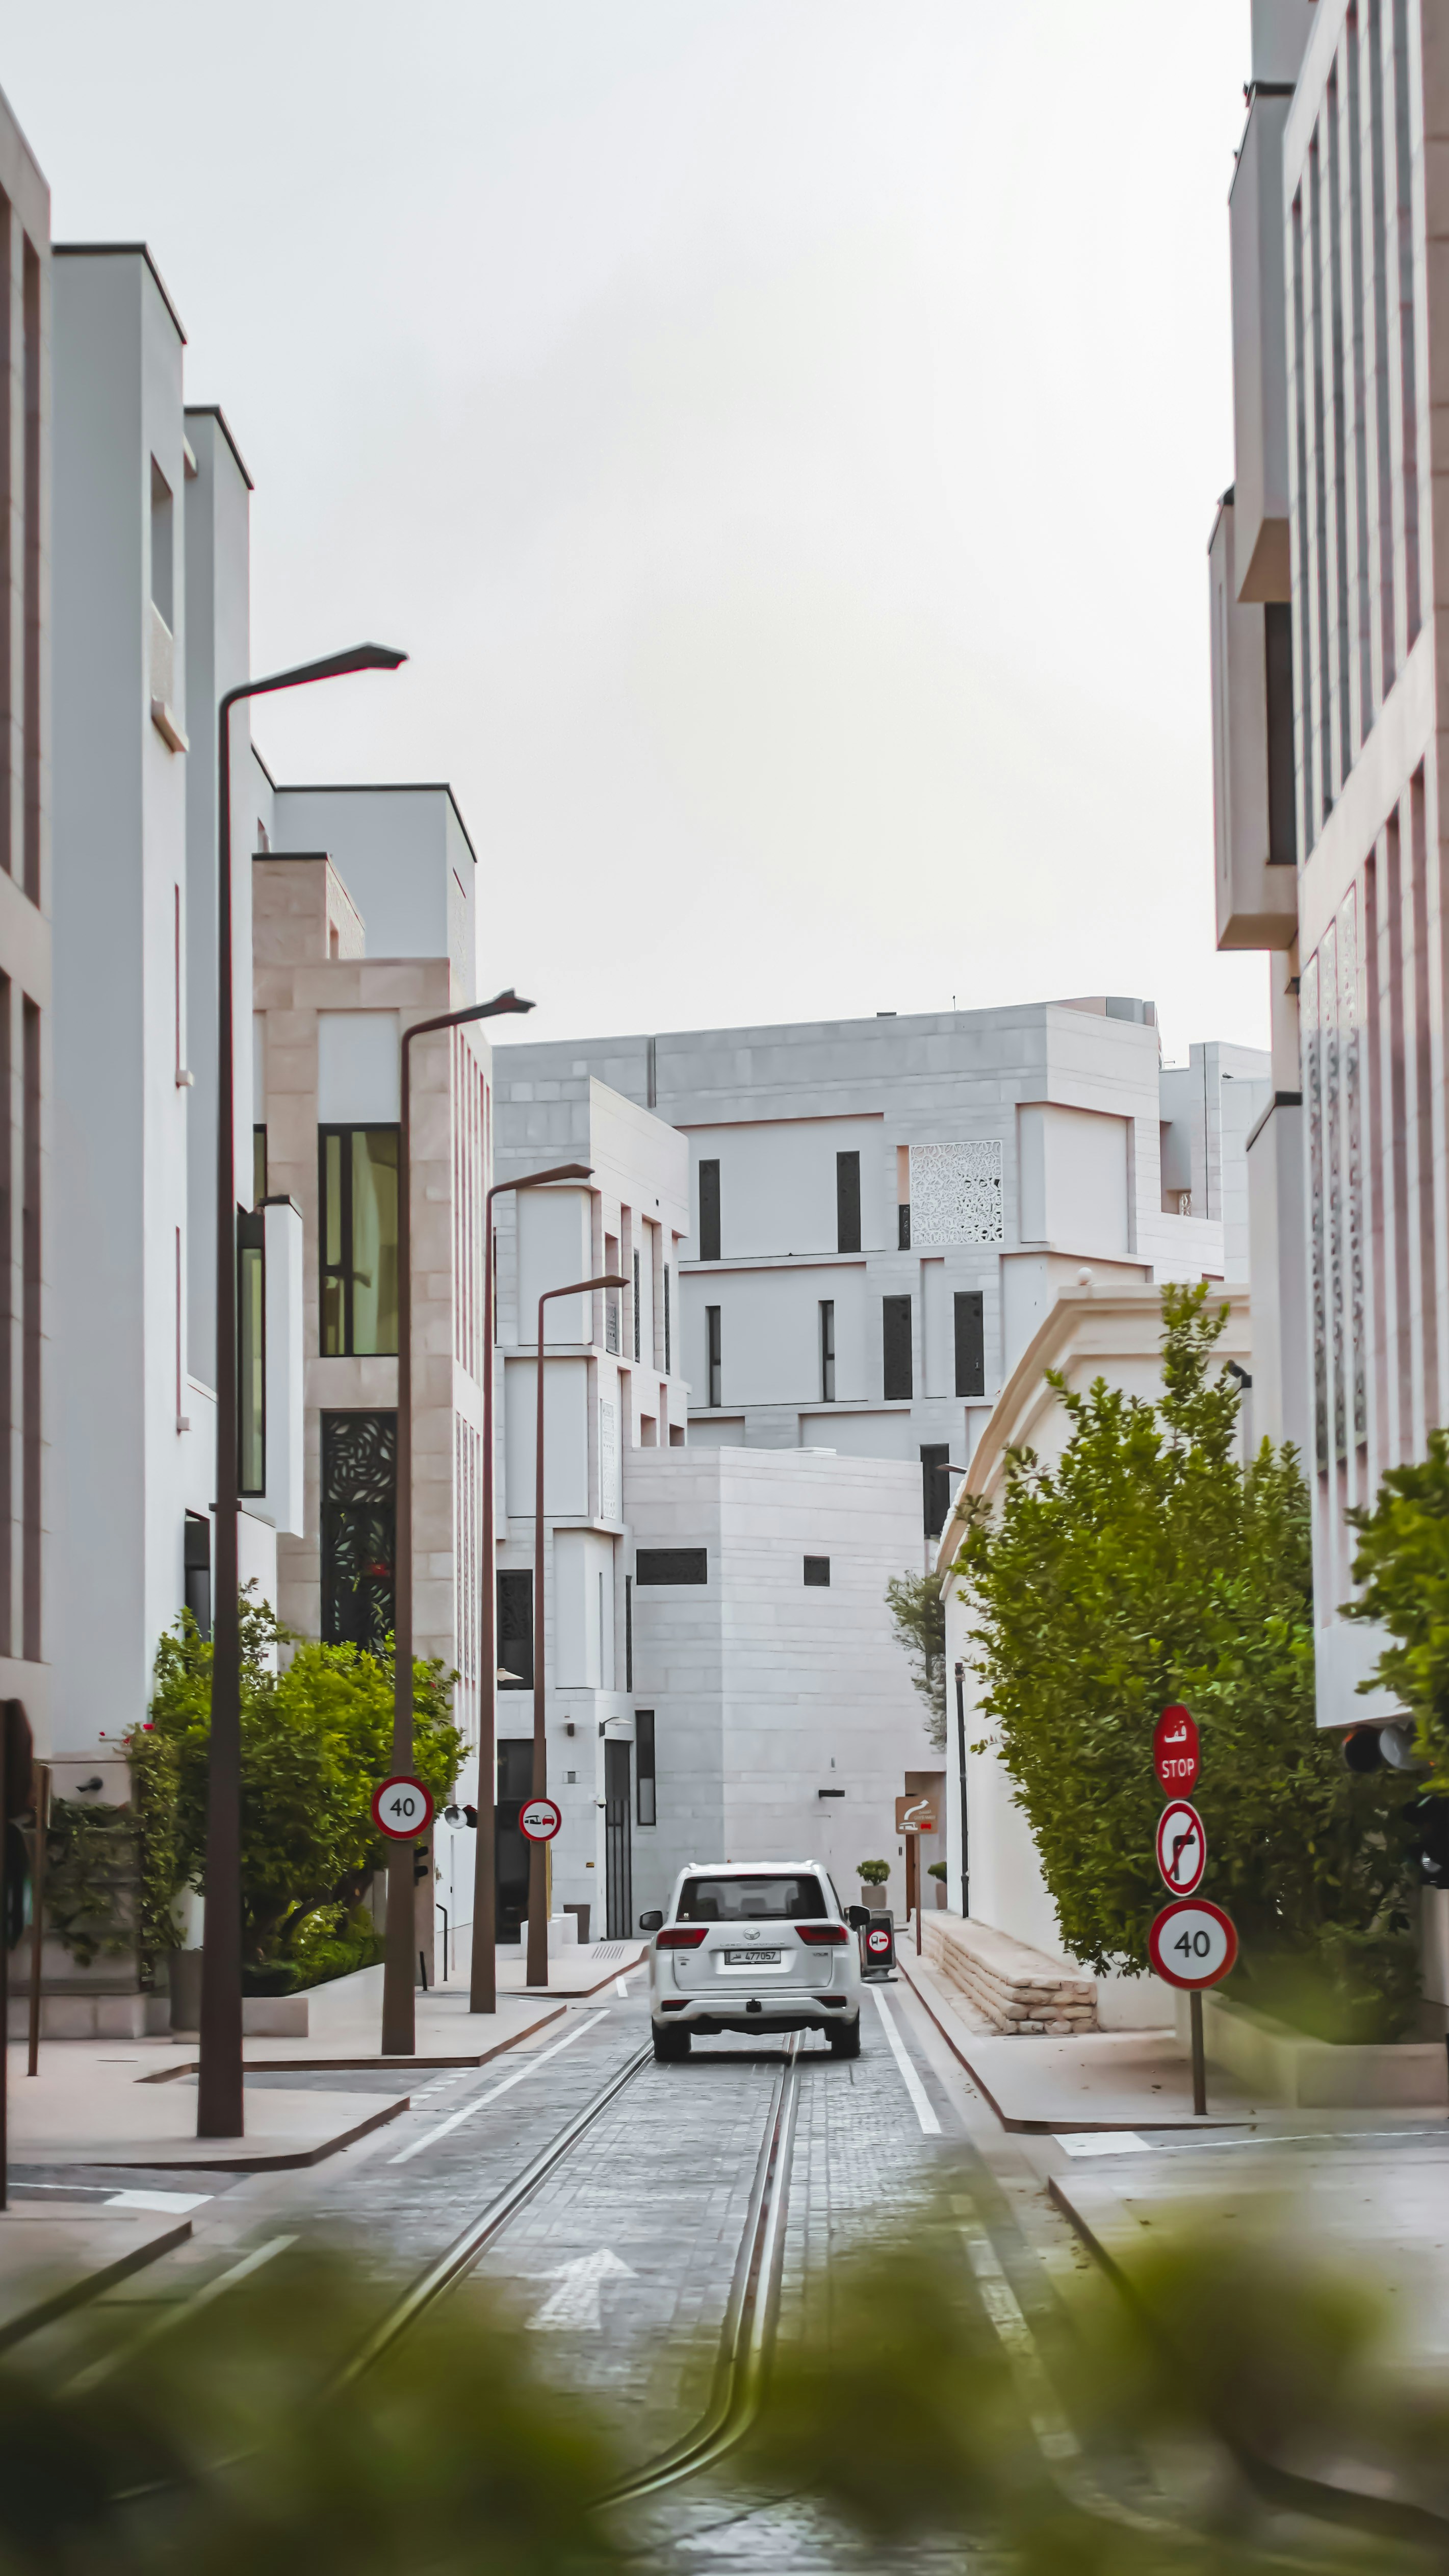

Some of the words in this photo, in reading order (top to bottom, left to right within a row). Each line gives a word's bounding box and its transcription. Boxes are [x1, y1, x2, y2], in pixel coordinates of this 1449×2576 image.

[1165, 1720, 1186, 1743] قف
[1162, 1758, 1194, 1778] STOP
[390, 1798, 415, 1817] 40
[1174, 1930, 1210, 1957] 40
[745, 1951, 776, 1960] 477057
